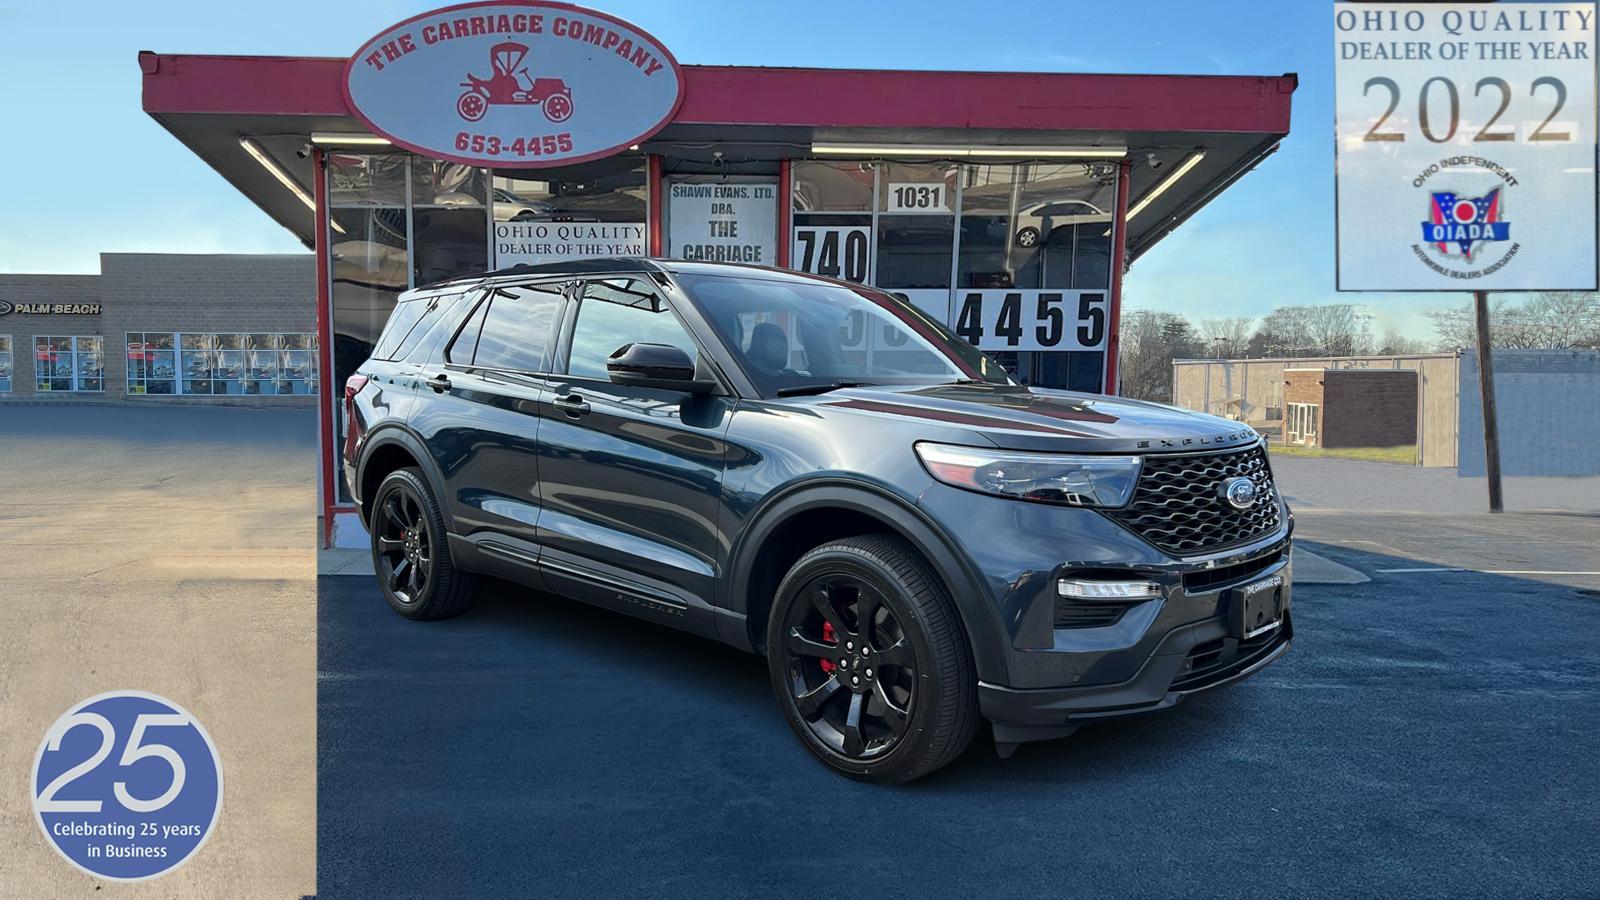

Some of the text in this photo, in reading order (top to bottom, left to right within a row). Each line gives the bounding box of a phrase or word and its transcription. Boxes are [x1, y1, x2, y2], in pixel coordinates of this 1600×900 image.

[1336, 10, 1593, 35] OHIO QUALITY
[366, 14, 664, 77] THE CARRIAGE COMPANY
[1340, 42, 1589, 60] DEALER OF THE YEAR
[1363, 76, 1571, 143] 2022
[454, 131, 574, 156] 653-4455
[1412, 156, 1519, 188] OHIO INDEPENDENT
[673, 186, 713, 199] SHAWN
[754, 186, 775, 199] LTD.
[894, 186, 940, 208] 1031
[711, 203, 736, 215] DBA.
[497, 226, 645, 241] OHIO QUALITY
[708, 221, 738, 238] THE
[1432, 224, 1495, 240] OIADA
[499, 243, 641, 255] DEALER OF THE YEAR
[683, 244, 762, 262] CARRIAGE
[796, 229, 868, 284] 740
[1411, 242, 1520, 279] AUTOMOBILE DEALERS ASSOCIATION
[15, 304, 51, 314] PALM
[54, 304, 100, 314] BEACH
[955, 292, 1105, 347] 4455
